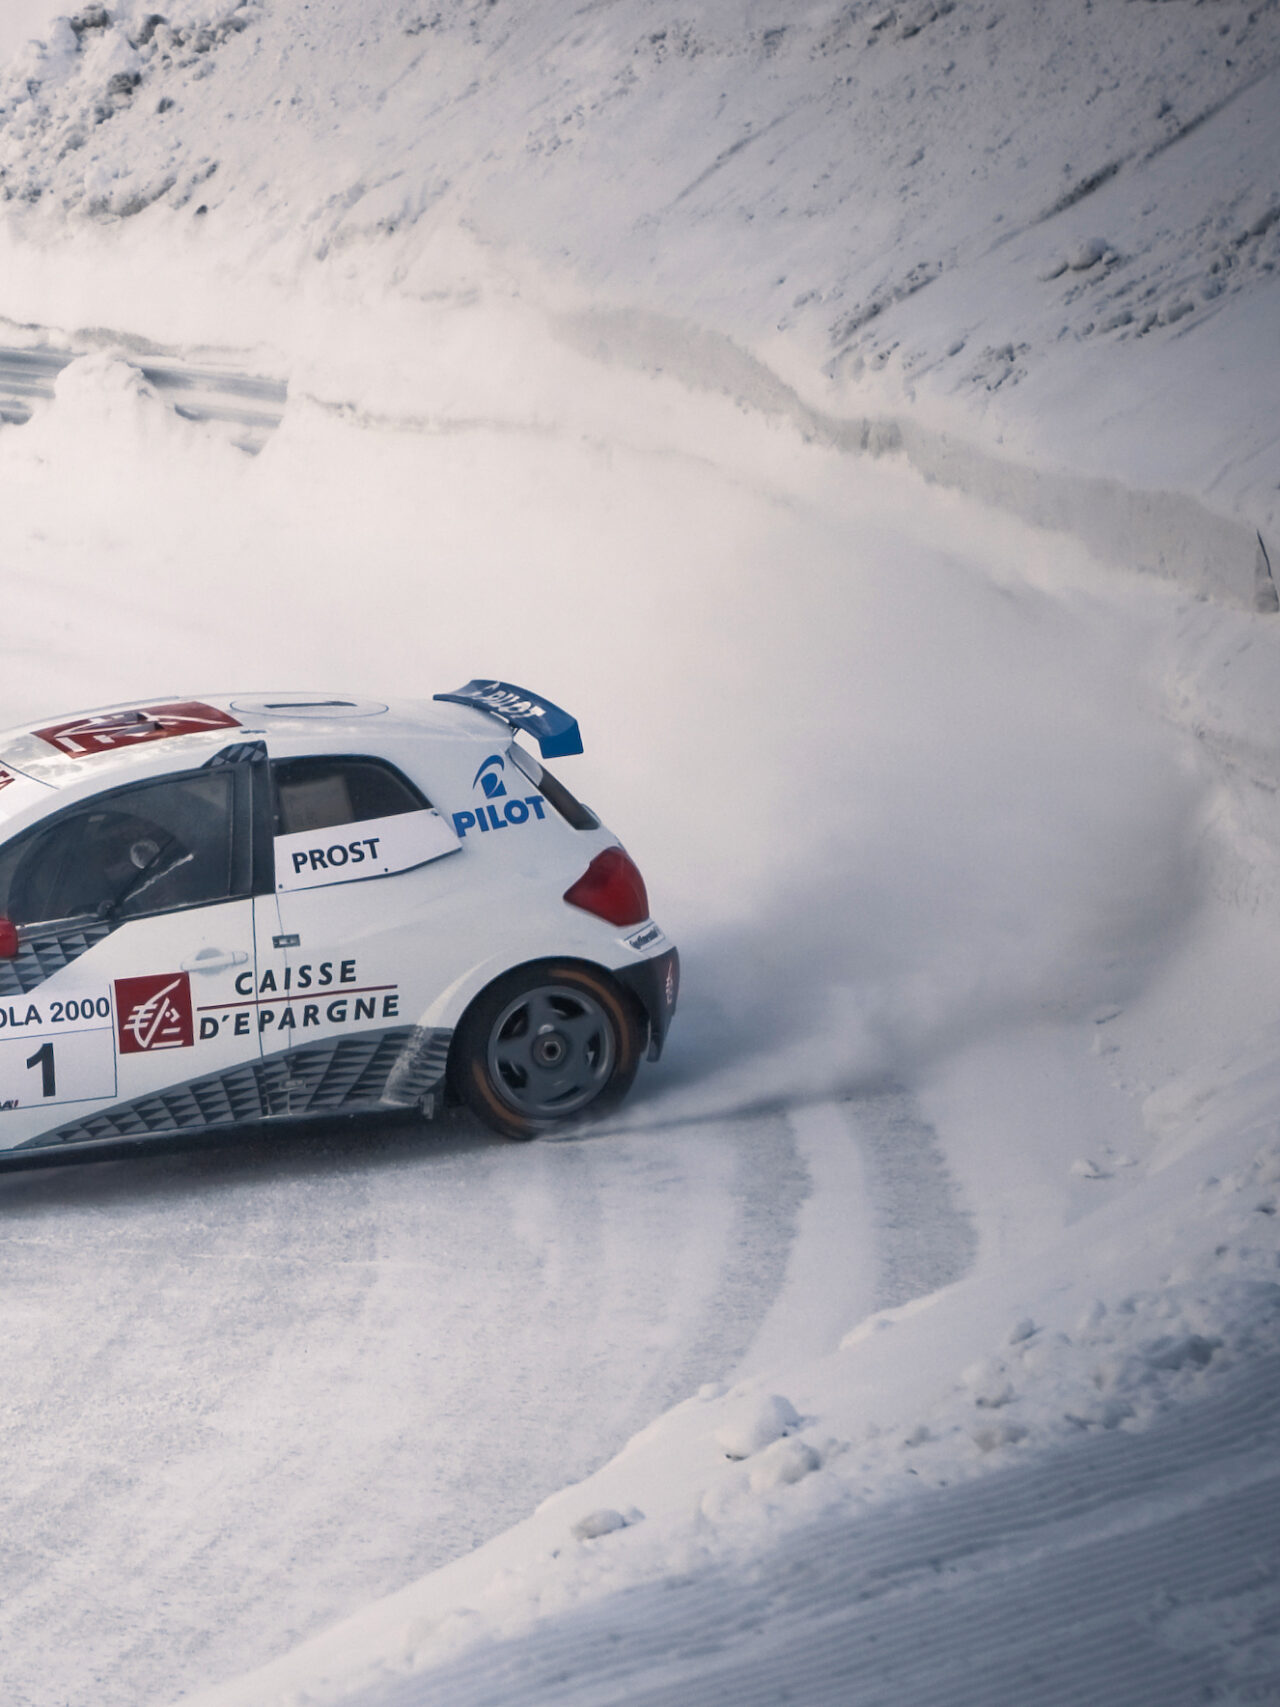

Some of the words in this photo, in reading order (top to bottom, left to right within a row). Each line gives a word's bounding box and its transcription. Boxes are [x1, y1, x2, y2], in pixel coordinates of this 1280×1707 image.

[476, 690, 546, 718] PILOT
[452, 795, 547, 838] PILOT
[291, 838, 381, 874] PROST
[234, 959, 358, 996] CAISSE
[49, 997, 111, 1023] 2000
[199, 995, 400, 1040] D'EPARGNE
[26, 1042, 57, 1098] 1
